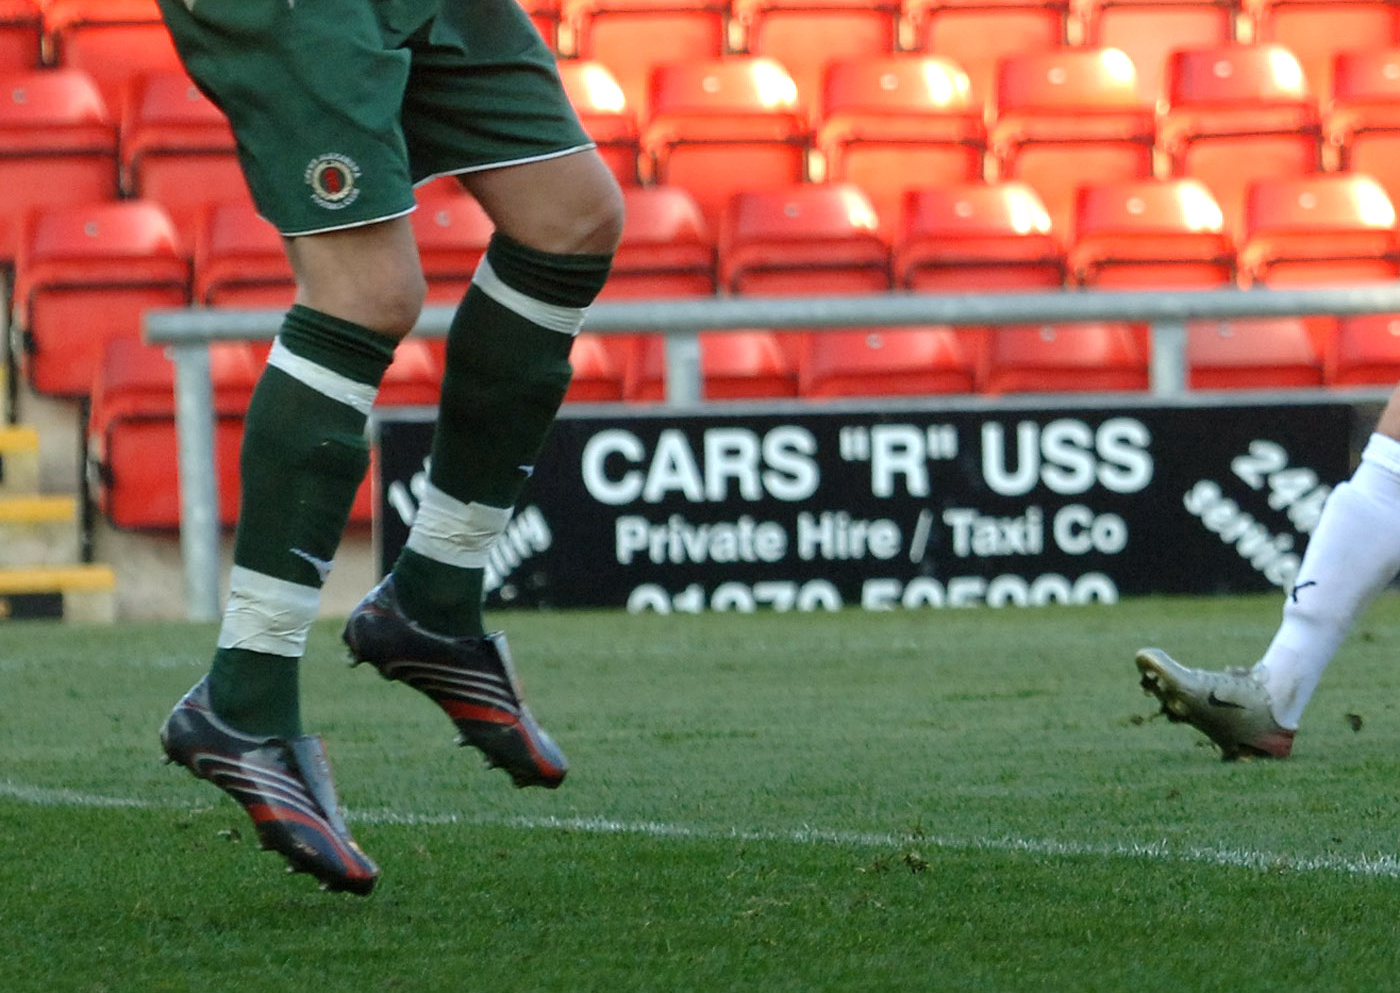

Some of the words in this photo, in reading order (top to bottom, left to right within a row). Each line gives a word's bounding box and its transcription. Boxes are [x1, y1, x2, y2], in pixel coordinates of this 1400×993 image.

[581, 425, 821, 504] CARS
[839, 424, 958, 497] "R"
[980, 418, 1155, 495] USS
[615, 513, 788, 564] Private
[797, 510, 898, 560] Hire
[909, 508, 934, 563] /
[942, 506, 1044, 557] Taxi
[1053, 504, 1129, 555] Co
